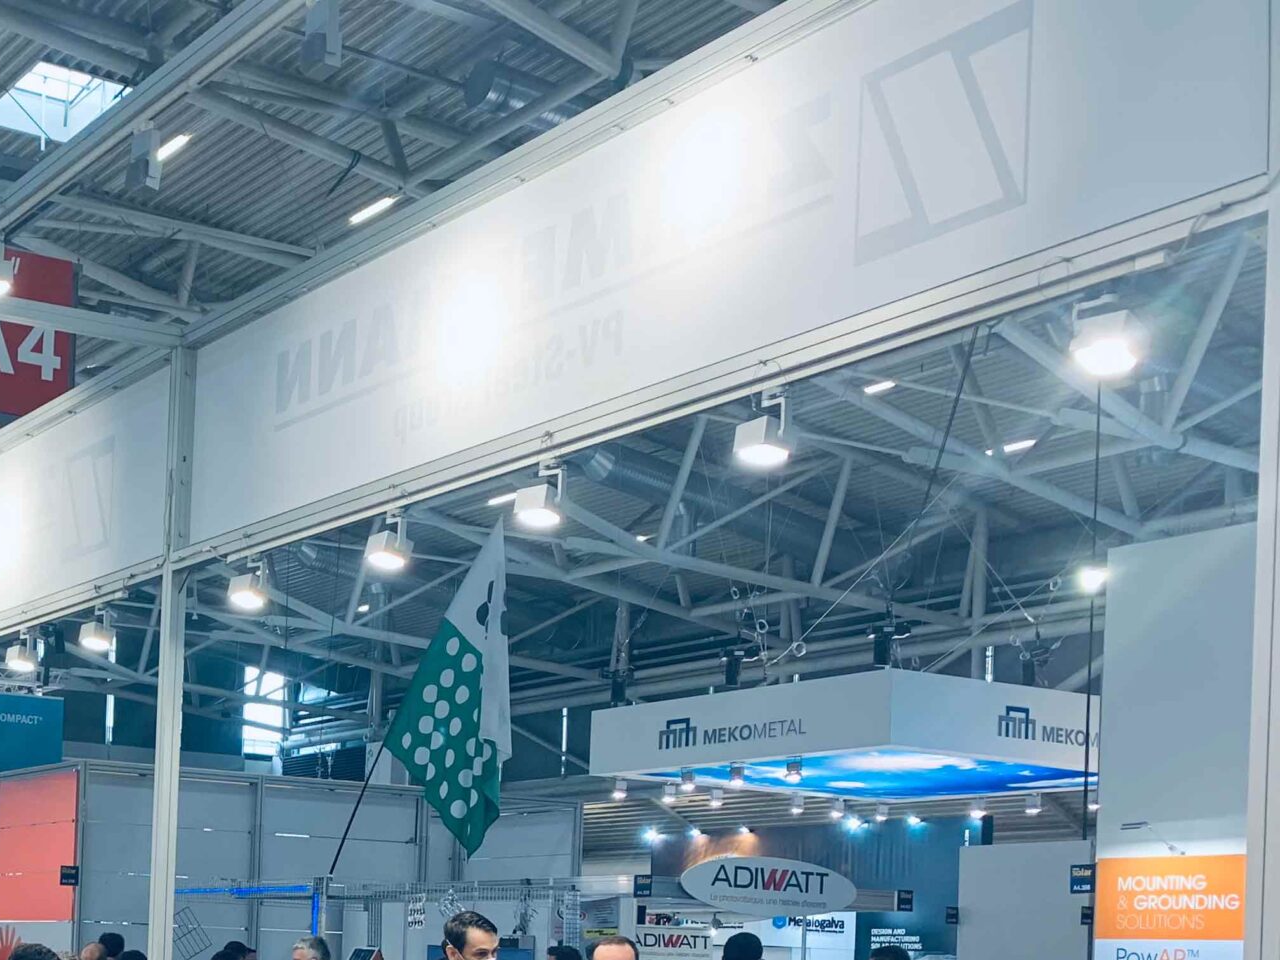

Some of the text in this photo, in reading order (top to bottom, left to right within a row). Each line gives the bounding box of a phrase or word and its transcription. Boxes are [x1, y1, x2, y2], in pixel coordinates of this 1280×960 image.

[703, 718, 807, 745] MEKOMETAL
[1041, 725, 1099, 748] MEKOM
[711, 863, 829, 894] ADIWATT
[1117, 874, 1207, 892] MOUNTING
[1117, 894, 1240, 911] & GROUNDING
[788, 917, 845, 930] Mealogalva
[1116, 913, 1205, 930] SOLUTIONS
